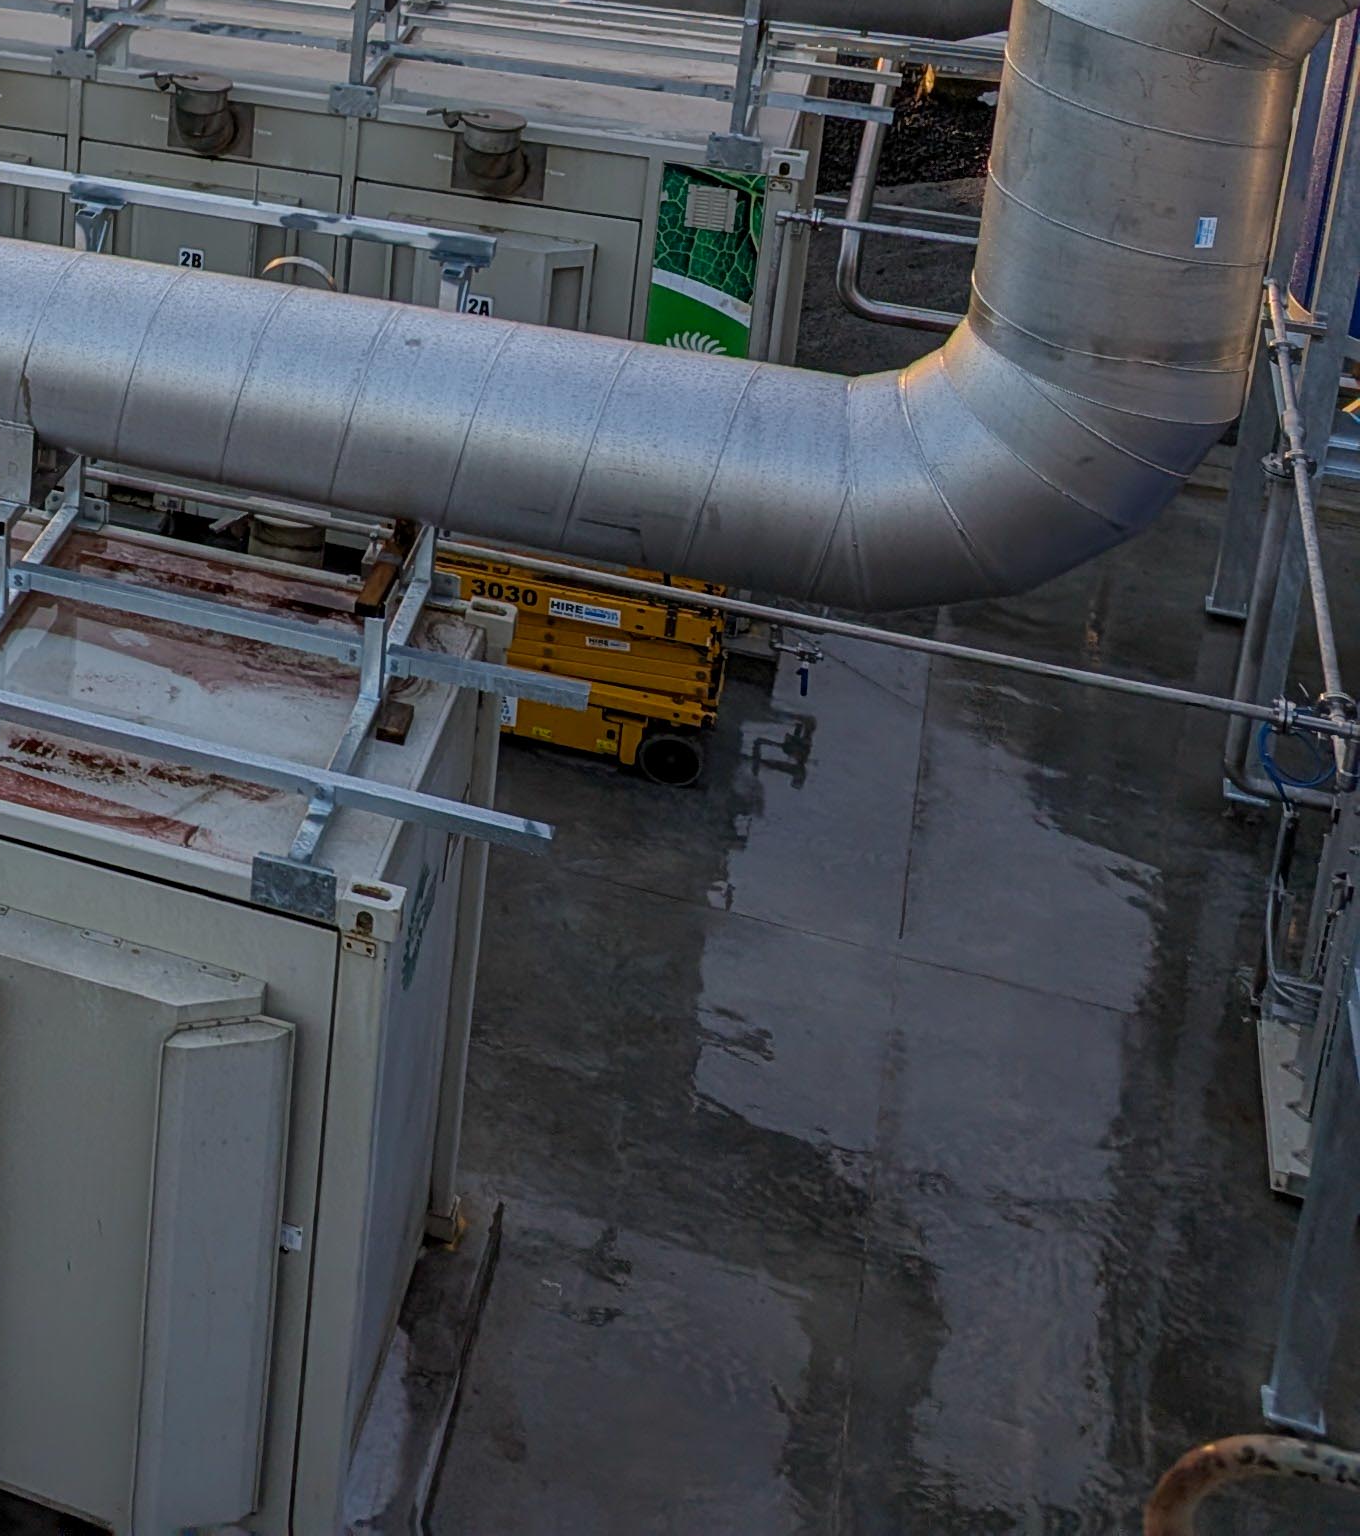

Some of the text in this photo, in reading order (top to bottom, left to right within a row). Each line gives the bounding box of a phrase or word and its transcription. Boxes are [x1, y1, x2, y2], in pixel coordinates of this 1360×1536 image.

[181, 251, 202, 268] 2B
[468, 298, 490, 317] 2A
[471, 579, 538, 607] 3030
[550, 600, 584, 615] HIRE
